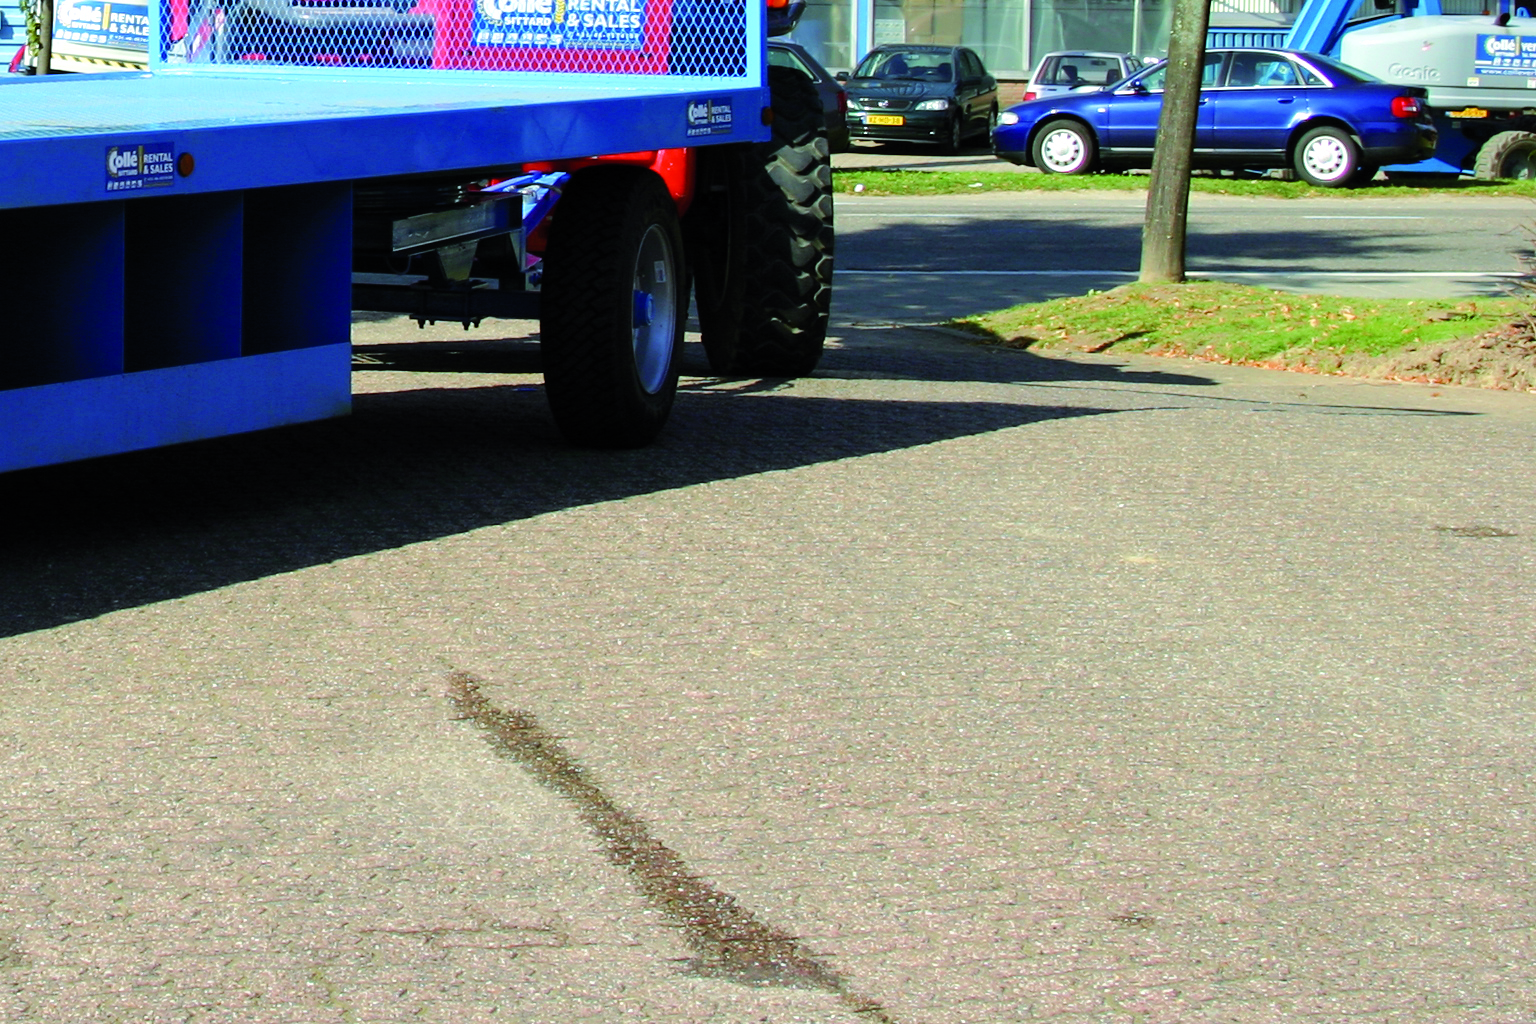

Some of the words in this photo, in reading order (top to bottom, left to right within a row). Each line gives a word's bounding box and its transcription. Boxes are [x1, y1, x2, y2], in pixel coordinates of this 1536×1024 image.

[111, 12, 149, 25] RENTA
[505, 17, 551, 26] SITTARD
[567, 13, 579, 27] &
[583, 14, 640, 28] SALES
[109, 23, 119, 33] &
[120, 24, 149, 35] SALE
[1485, 37, 1516, 54] Collé
[108, 150, 138, 174] Collé
[144, 152, 173, 164] RENTAL
[150, 163, 173, 174] SALES
